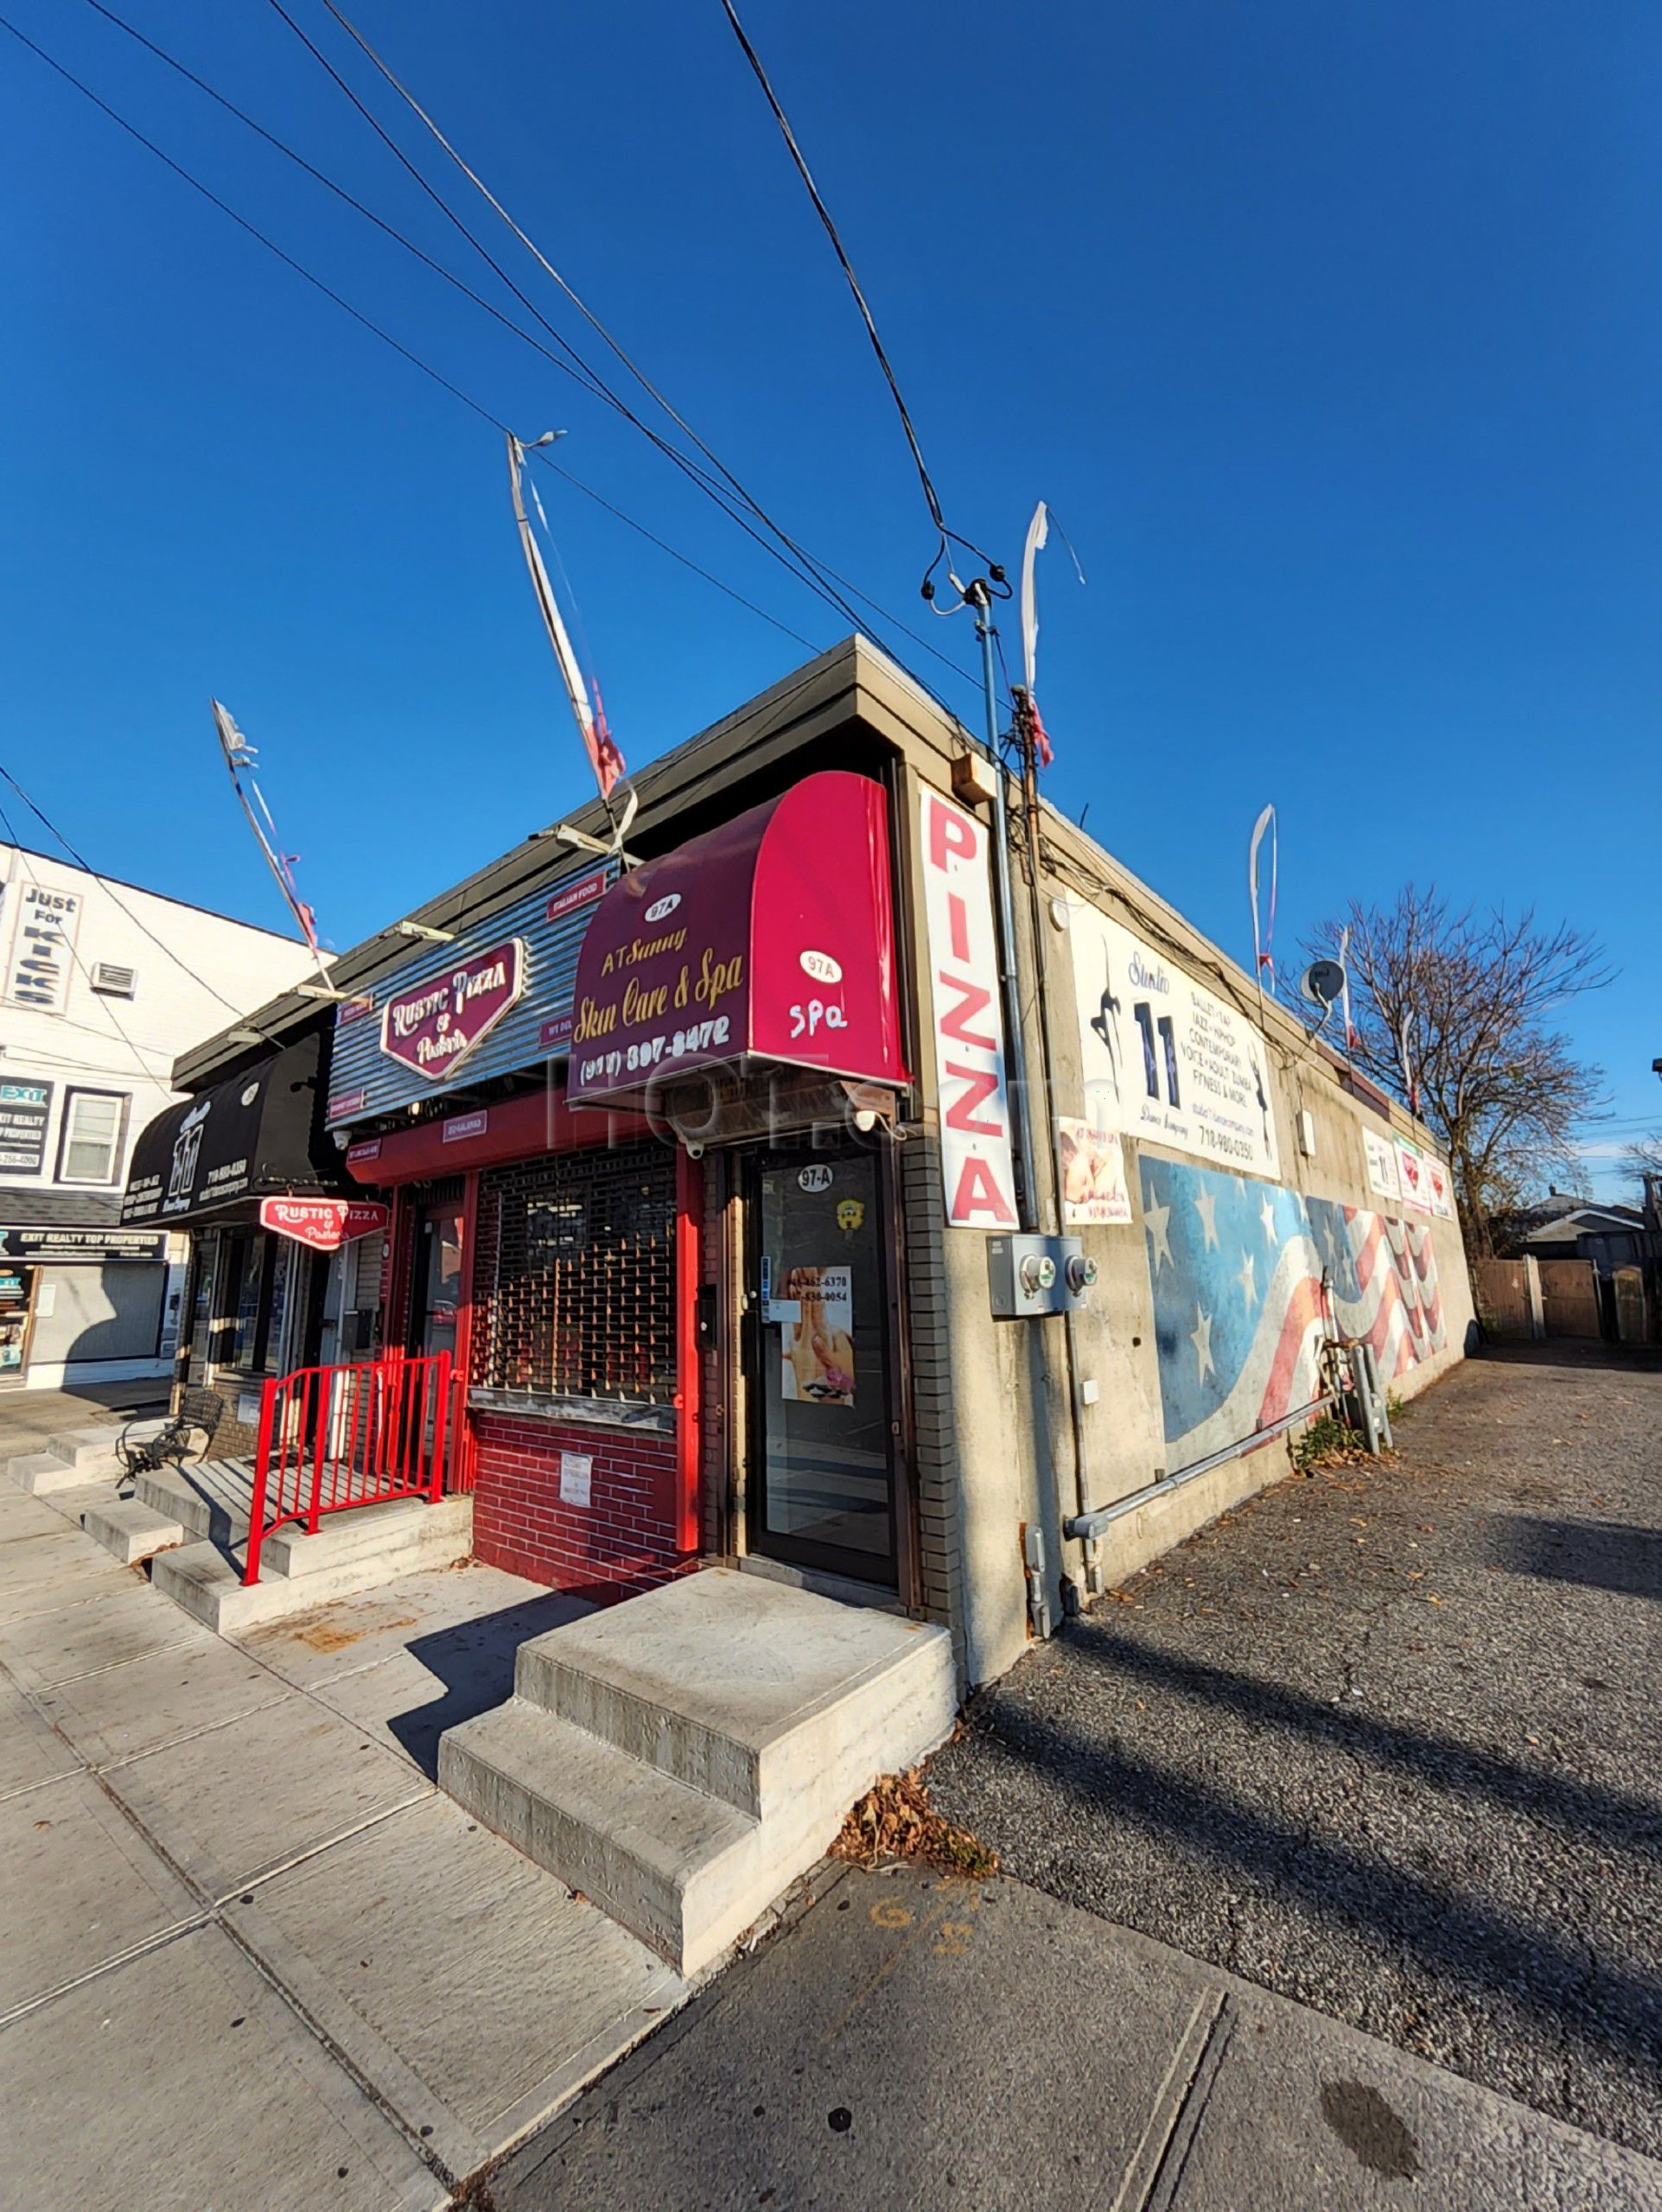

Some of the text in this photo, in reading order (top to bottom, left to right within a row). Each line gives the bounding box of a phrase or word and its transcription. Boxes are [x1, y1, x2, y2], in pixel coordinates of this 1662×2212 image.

[25, 888, 77, 912] Just
[650, 899, 675, 918] 97A
[15, 925, 66, 1004] KICKS
[808, 956, 835, 978] 97A
[574, 948, 743, 1043] Skin Care & Spa
[929, 794, 1017, 1224] PIZZA
[2, 1084, 47, 1103] EXIT
[801, 1168, 831, 1186] 97-A
[275, 1204, 379, 1224] RUSTIC PIZZA
[20, 1233, 45, 1243] EXIT
[46, 1234, 84, 1244] REALTY
[85, 1235, 104, 1244] TOP
